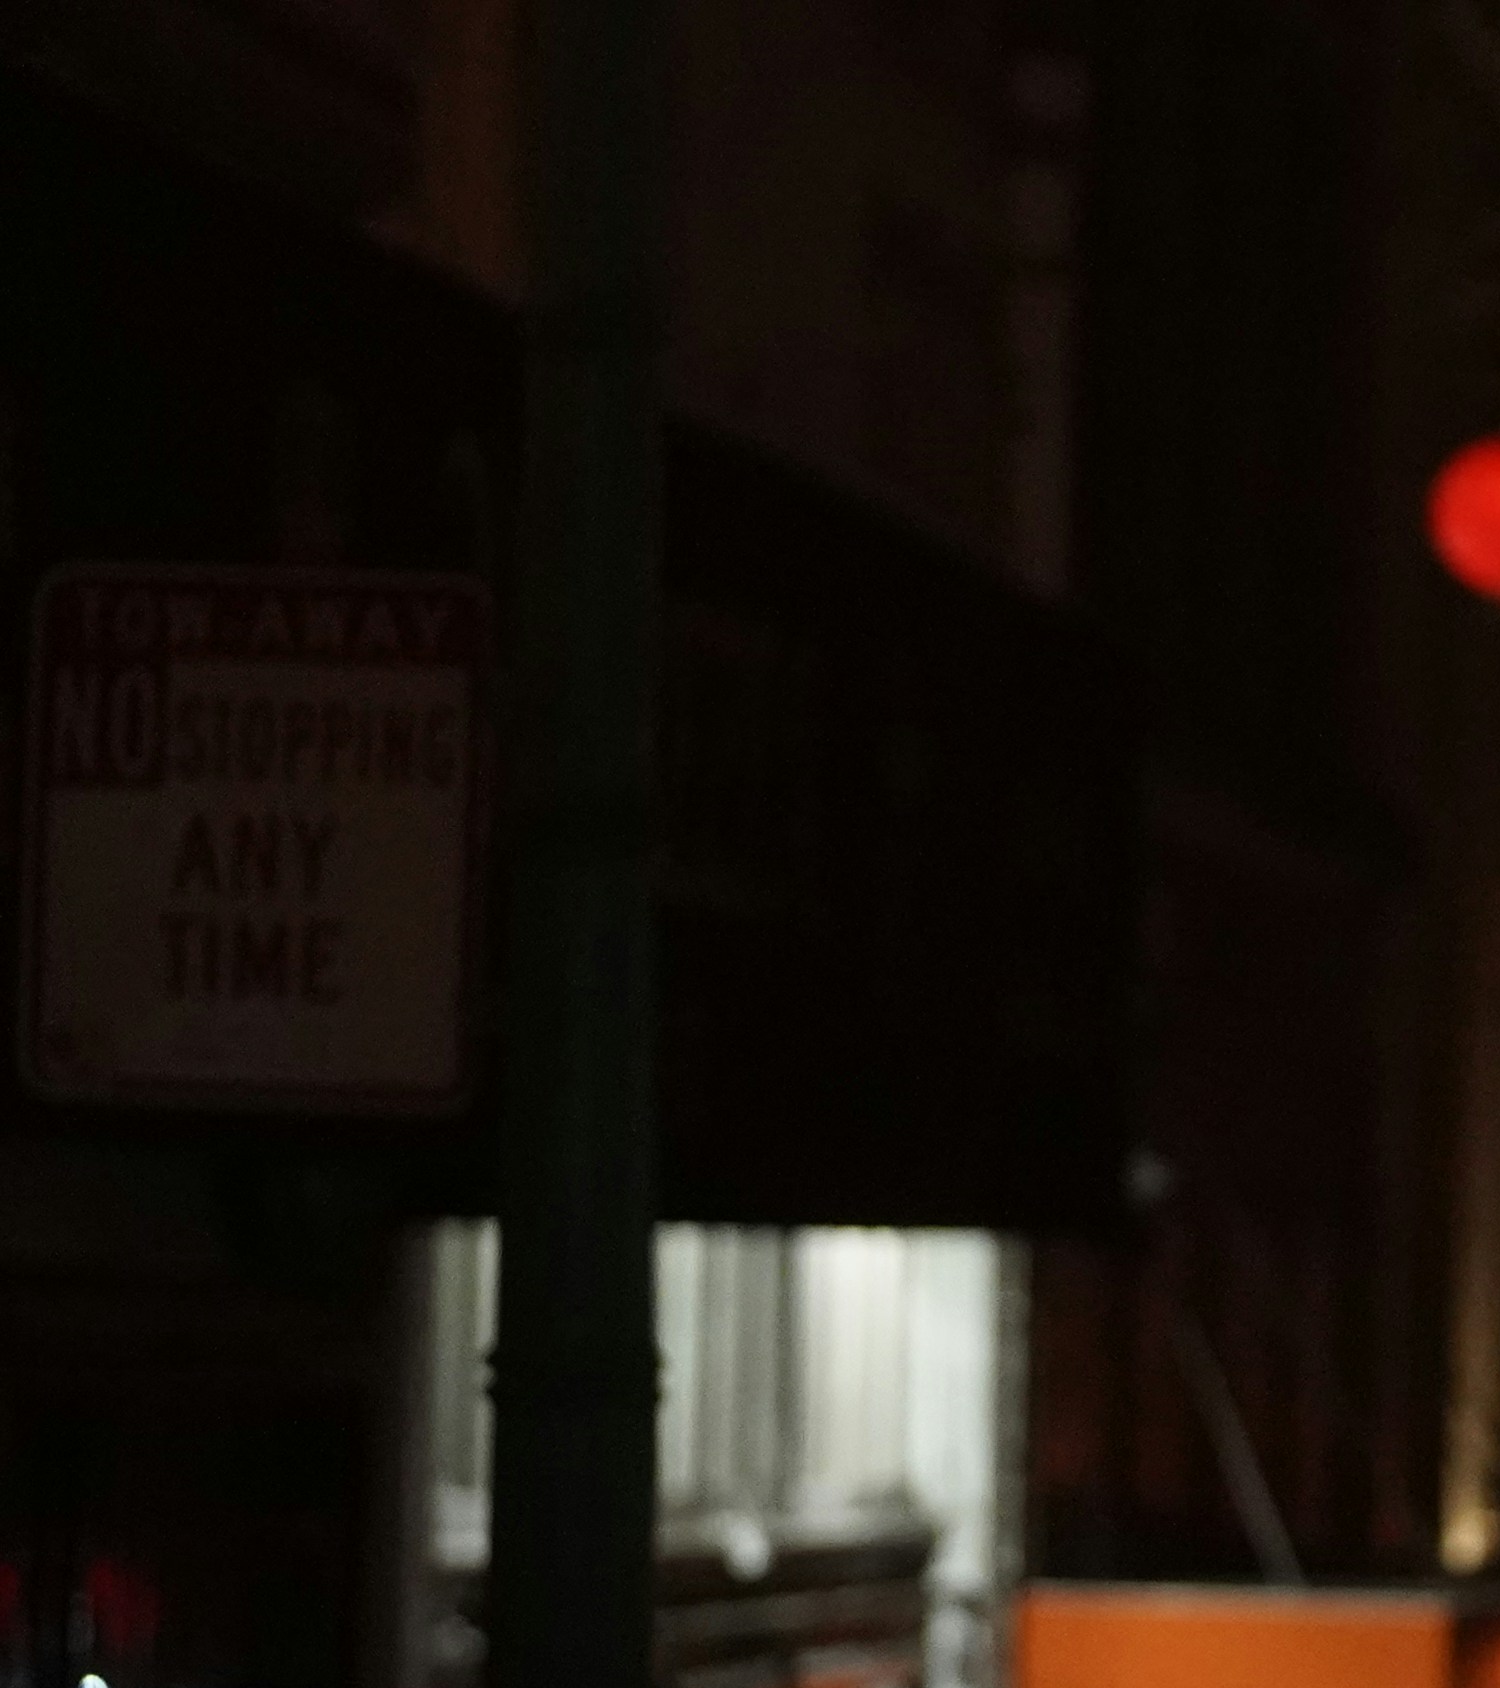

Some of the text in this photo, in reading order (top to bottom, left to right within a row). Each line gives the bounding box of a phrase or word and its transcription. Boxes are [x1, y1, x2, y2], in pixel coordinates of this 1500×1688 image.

[76, 587, 454, 650] TOW-AWAY
[53, 665, 458, 788] NO STOPPING
[170, 812, 340, 898] ANY
[159, 912, 345, 1005] TIME
